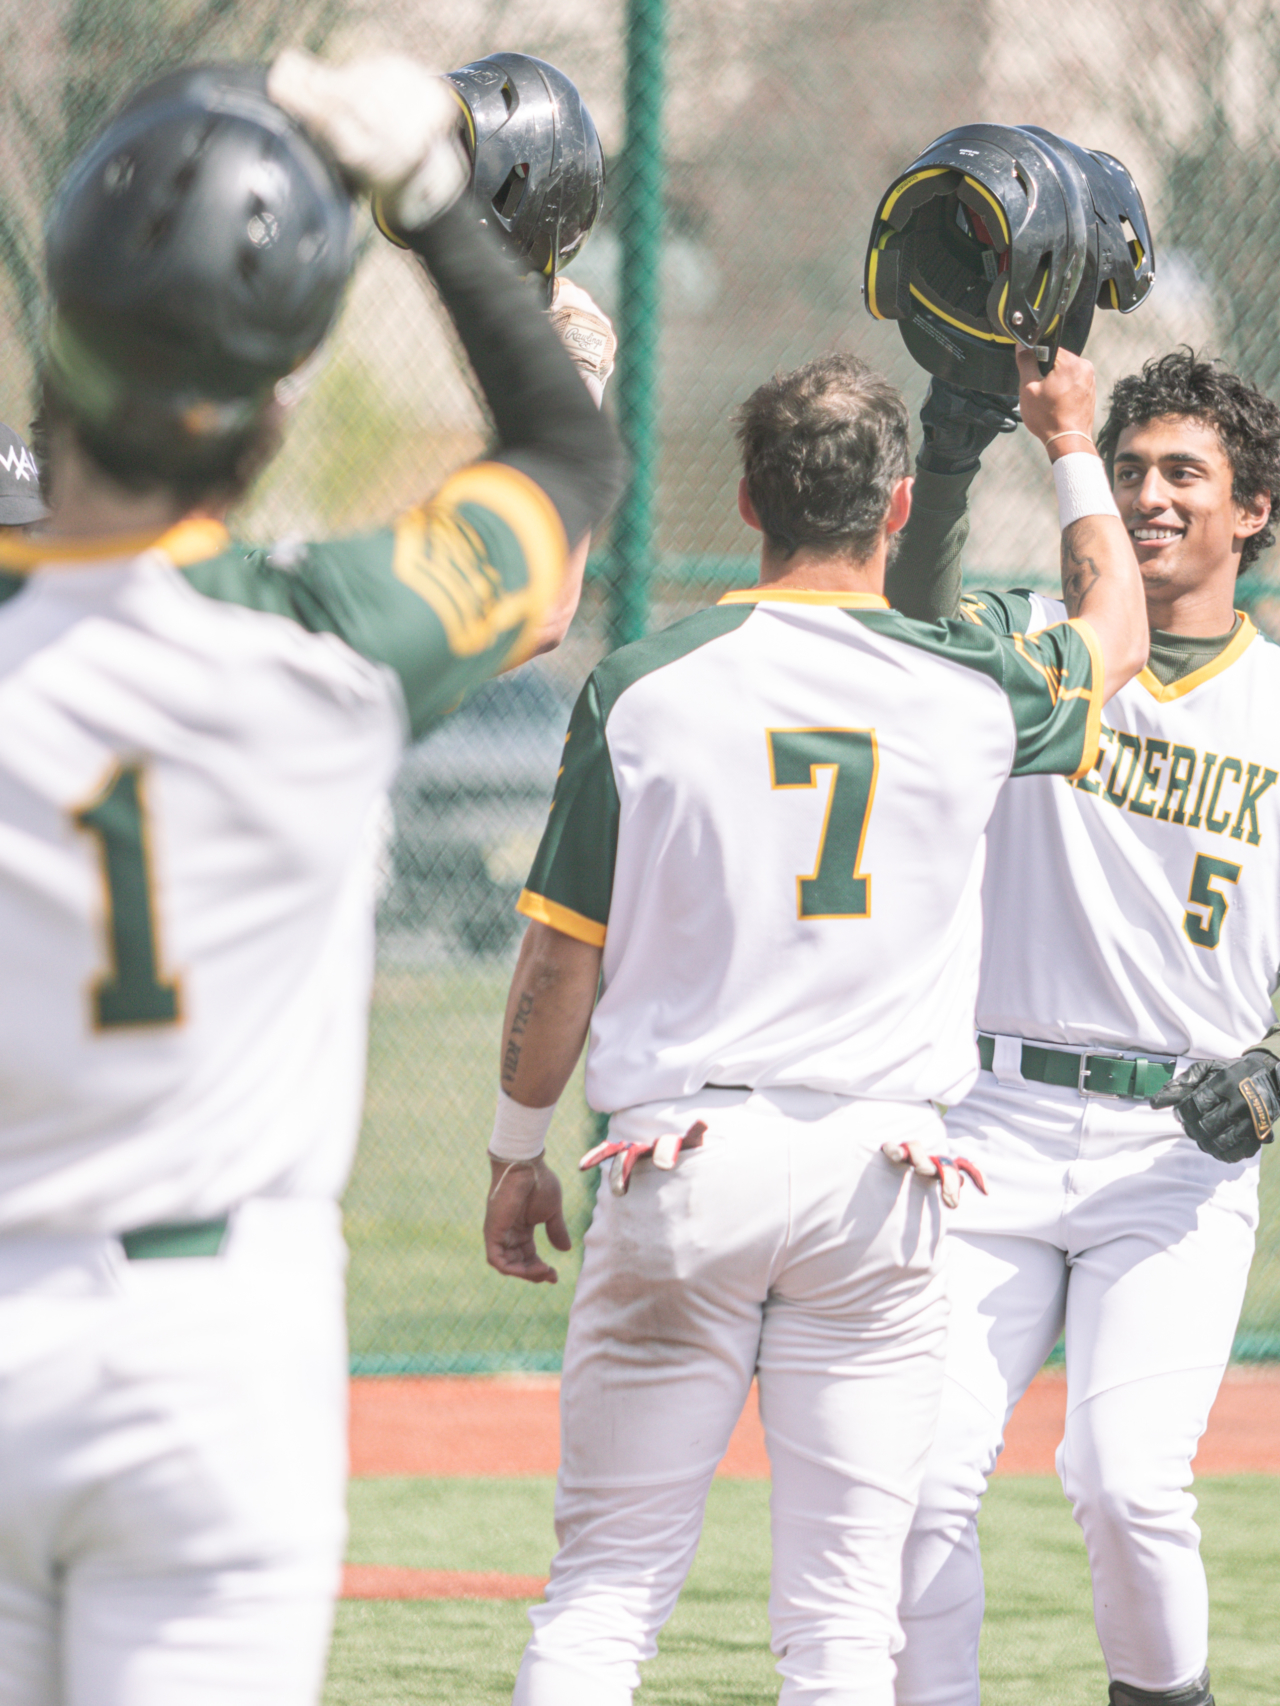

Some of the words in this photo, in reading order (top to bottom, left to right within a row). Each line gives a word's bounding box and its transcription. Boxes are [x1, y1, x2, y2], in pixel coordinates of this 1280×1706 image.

[565, 327, 603, 350] Rawlings
[765, 727, 879, 920] 7
[1065, 723, 1279, 847] EDERICK
[71, 757, 187, 1034] 1
[1182, 852, 1243, 951] 5
